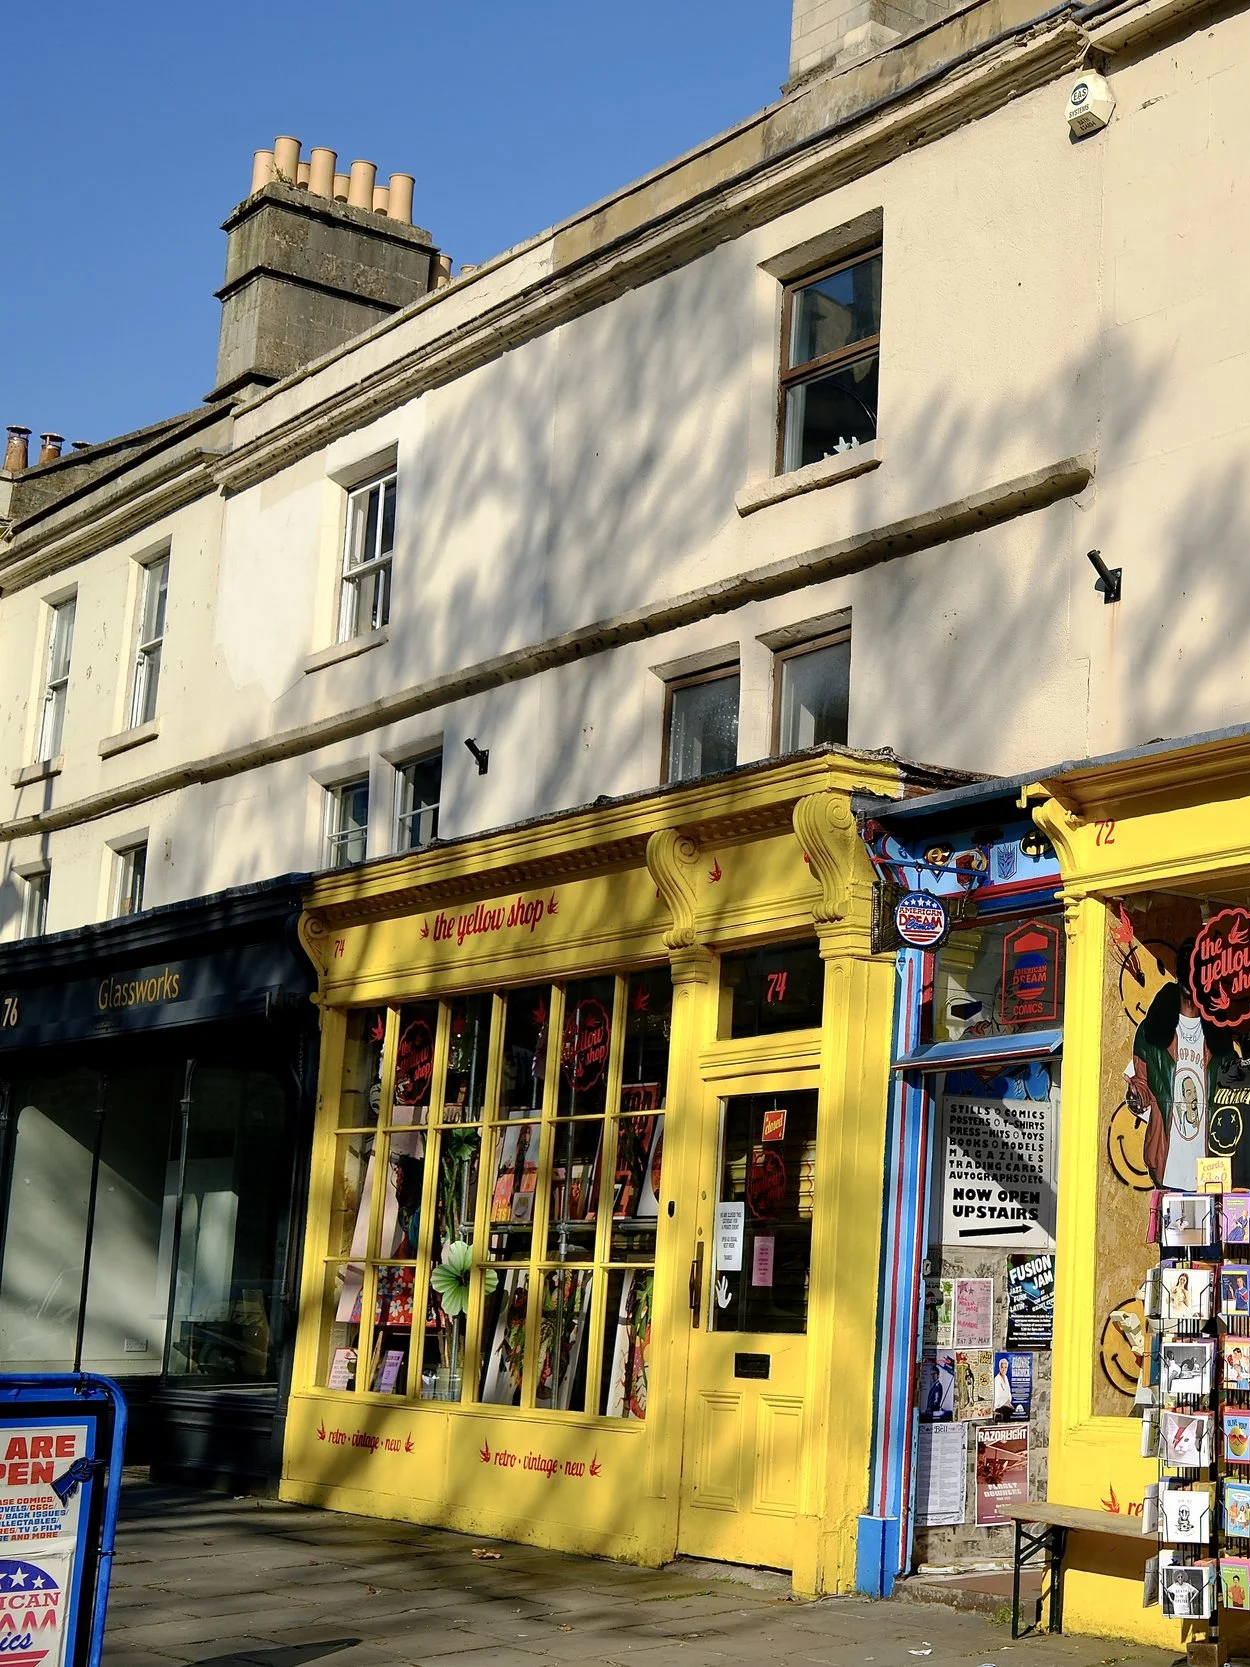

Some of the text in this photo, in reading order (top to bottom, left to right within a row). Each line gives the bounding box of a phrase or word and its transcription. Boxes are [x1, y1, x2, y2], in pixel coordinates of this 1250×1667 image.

[1073, 88, 1087, 101] EAS
[1094, 818, 1116, 847] 72
[899, 907, 942, 916] AMERICAN
[433, 896, 544, 947] the yellow shop
[898, 914, 942, 928] DREAM
[334, 939, 345, 958] 74
[1200, 935, 1222, 960] the
[1013, 965, 1048, 976] AMERICAN
[1012, 972, 1047, 985] DREAM
[98, 967, 180, 1010] Glassworks
[767, 971, 788, 1003] 74
[2, 997, 18, 1028] 76
[1013, 1002, 1044, 1016] COMICS
[950, 1104, 1045, 1120] STILLS COMICS
[765, 1113, 783, 1135] closed
[950, 1116, 1045, 1130] POSTERS T-SHIRTS
[949, 1126, 1045, 1141] PRESS-KITS TOYS
[949, 1138, 1044, 1152] BOOKS MODELS
[949, 1160, 1044, 1174] TRADING CARDS
[953, 1188, 1040, 1204] NOW OPEN
[952, 1205, 1039, 1221] UPSTAIRS
[1009, 1254, 1052, 1285] FUSION
[1032, 1270, 1053, 1290] JAM
[1010, 1285, 1023, 1296] JAZZ
[1013, 1293, 1028, 1303] FUNK
[1009, 1302, 1026, 1313] LATIN
[934, 1425, 948, 1434] Bell
[978, 1429, 1027, 1442] RAZORLIGHT
[5, 1434, 76, 1460] ARE
[328, 1429, 402, 1454] retro vintage new
[494, 1451, 585, 1478] retro vintage new
[41, 1524, 62, 1532] FILM
[11, 1533, 30, 1541] AND
[32, 1532, 58, 1540] MORE
